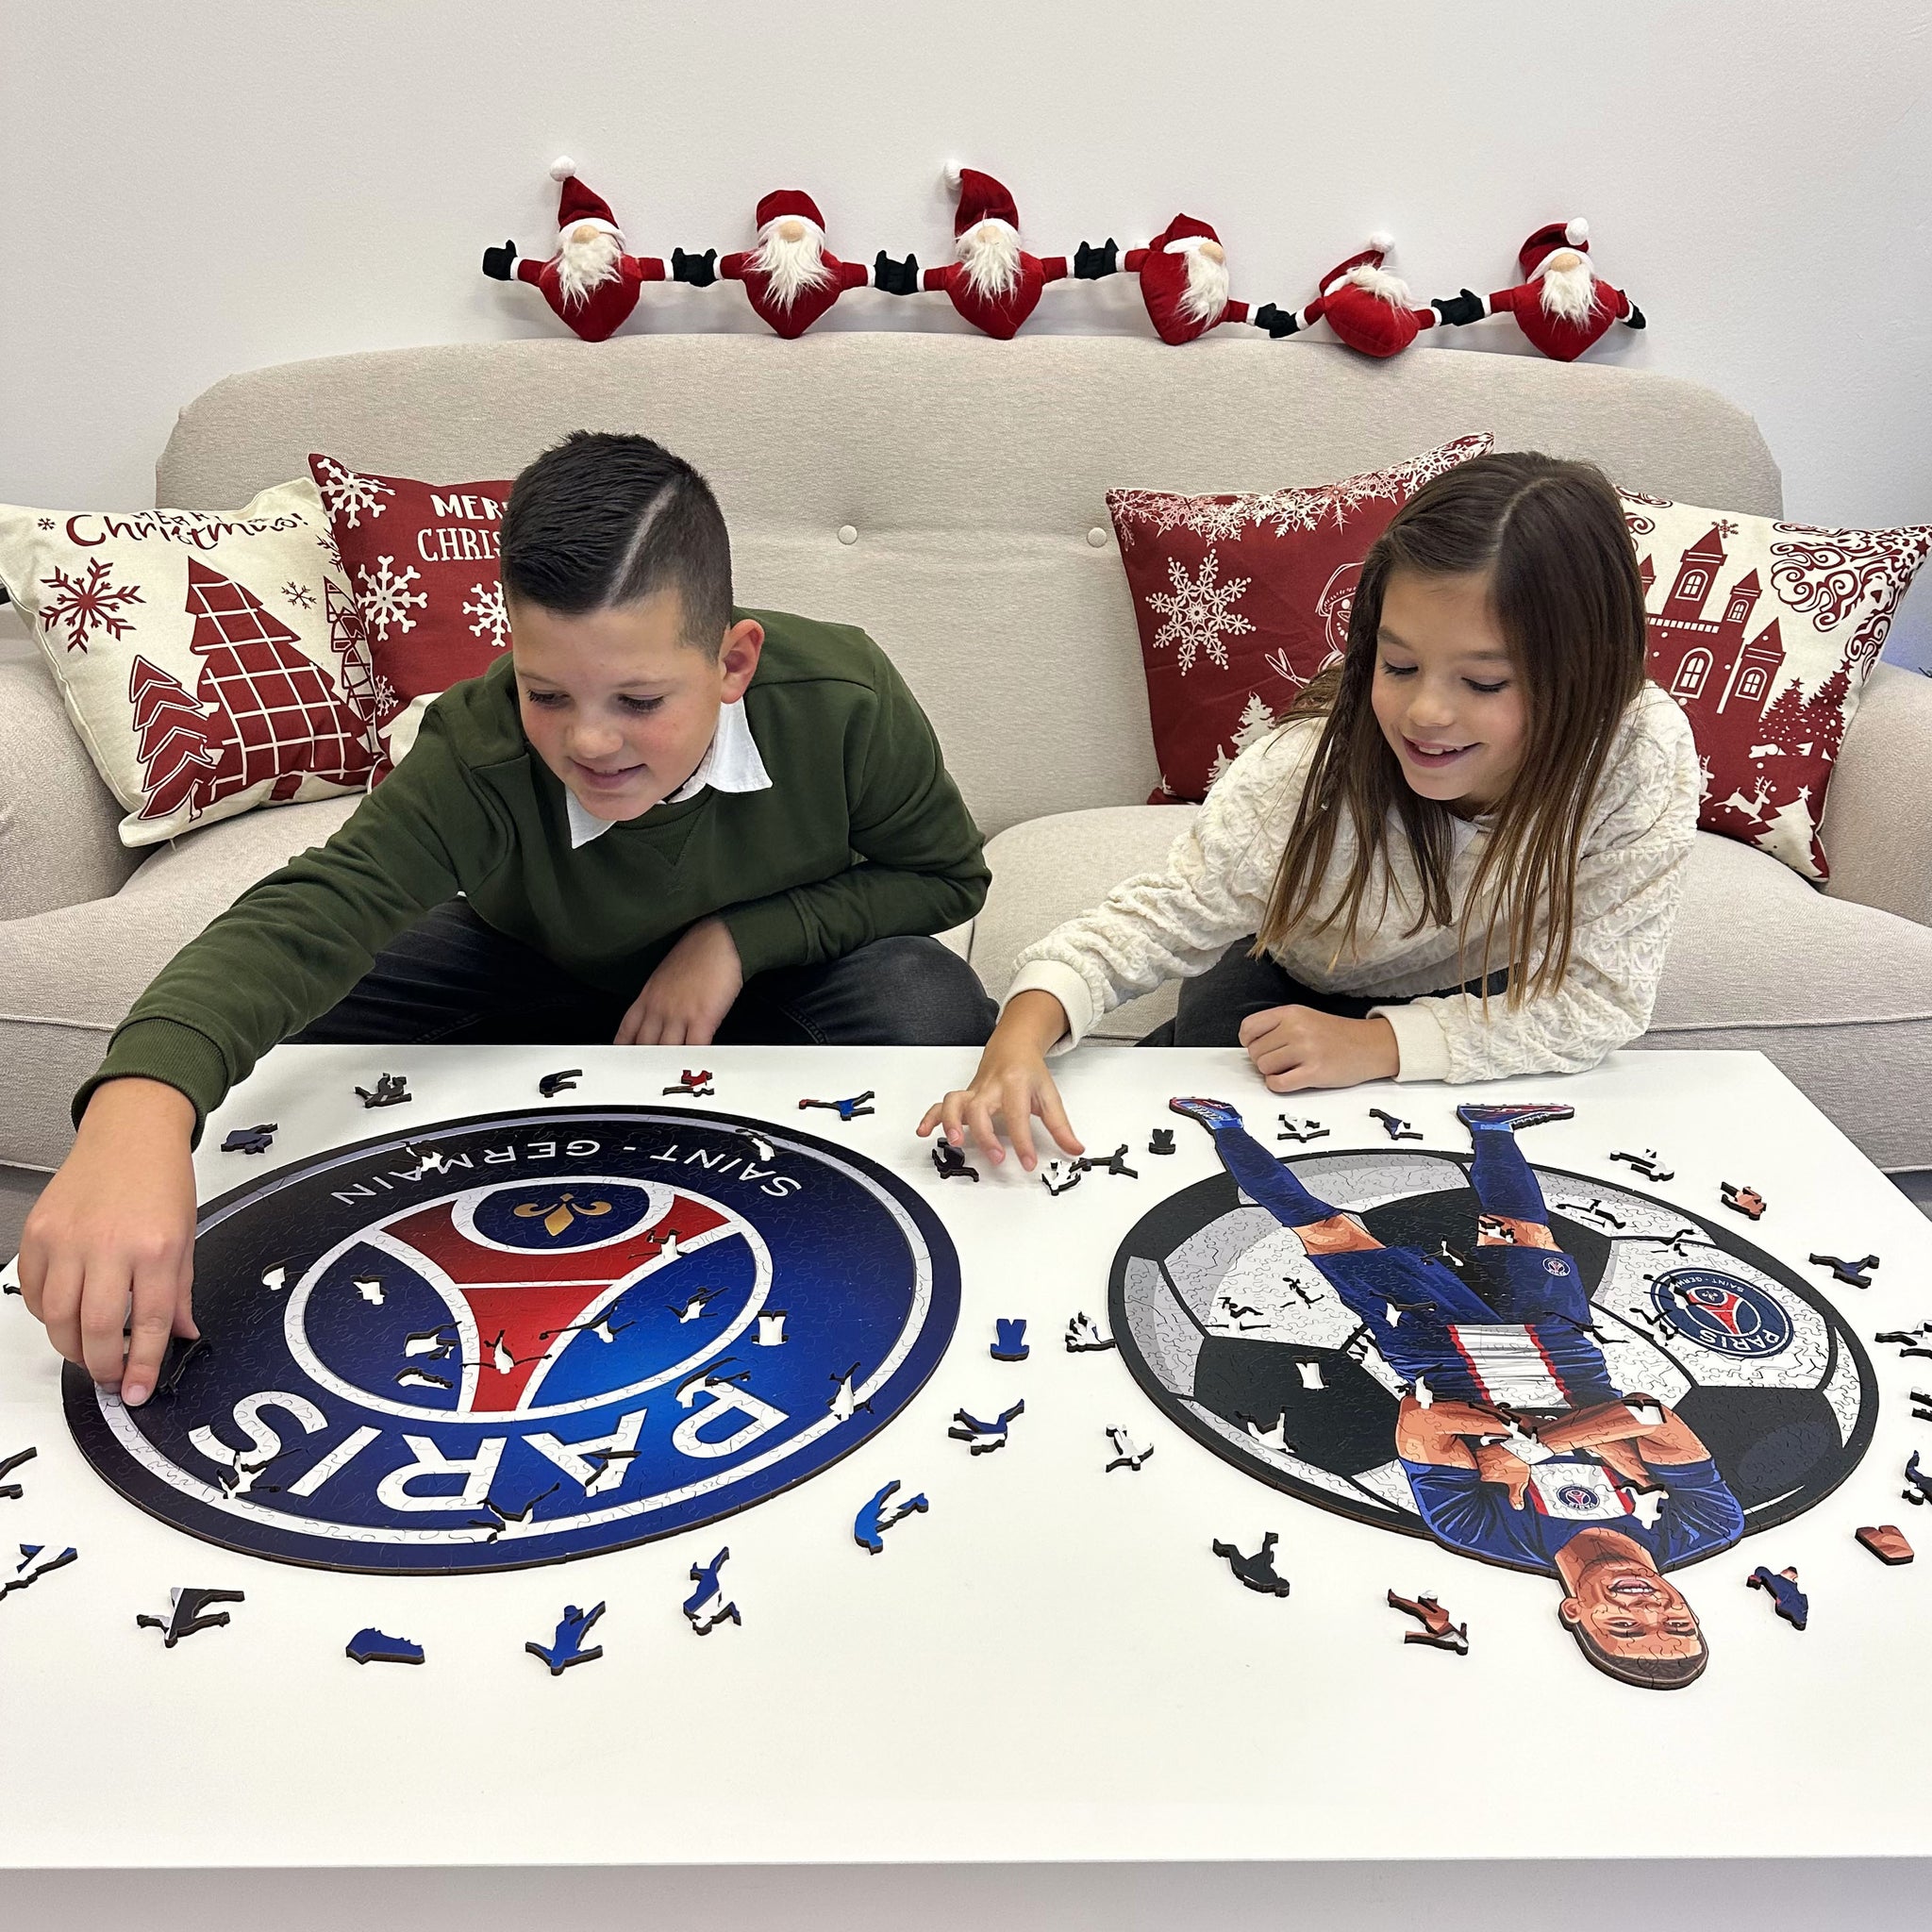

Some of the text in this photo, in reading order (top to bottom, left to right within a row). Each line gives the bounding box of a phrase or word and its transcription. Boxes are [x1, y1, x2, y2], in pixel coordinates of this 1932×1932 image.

[330, 1140, 601, 1206] GERMAIN
[649, 1144, 802, 1198] SAINT
[1711, 1277, 1745, 1293] SAINT
[1699, 1328, 1781, 1351] PARIS
[187, 1380, 791, 1513] PARIS
